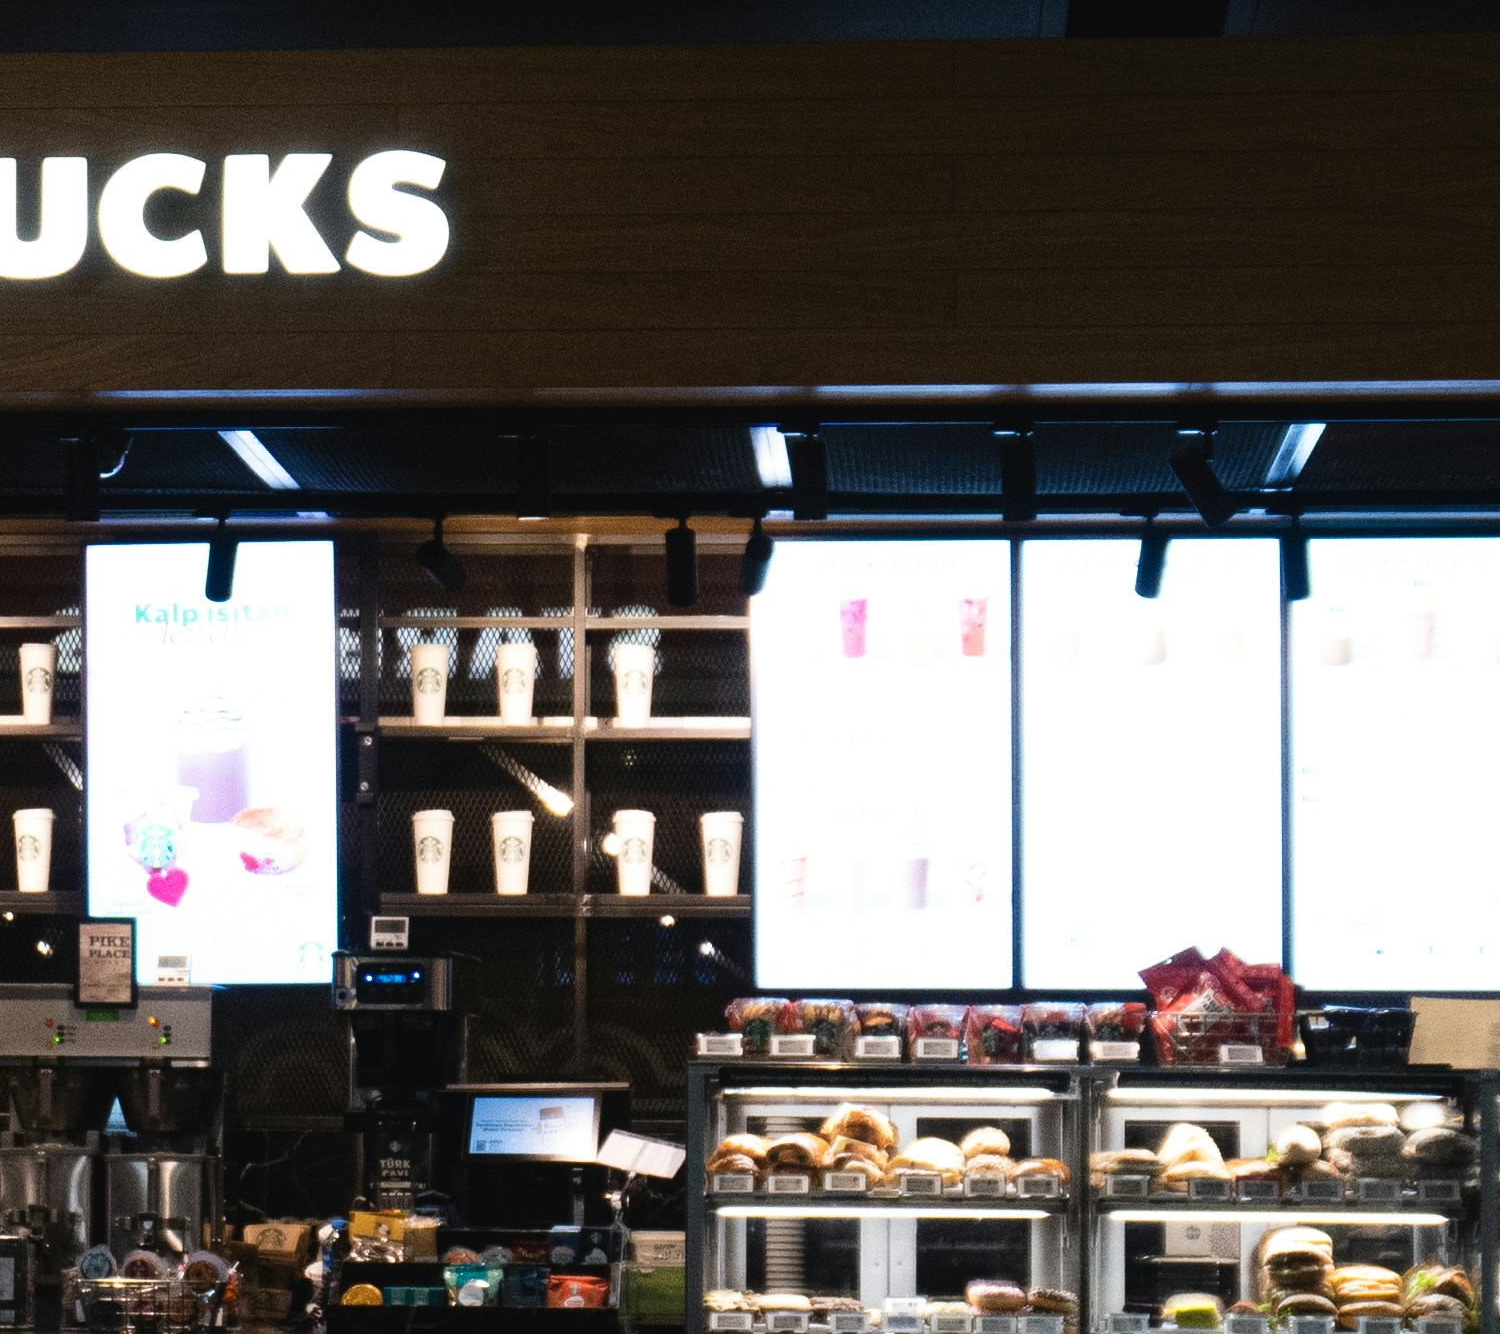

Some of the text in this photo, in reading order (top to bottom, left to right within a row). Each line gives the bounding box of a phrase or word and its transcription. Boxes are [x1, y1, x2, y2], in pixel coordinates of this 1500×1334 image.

[134, 602, 200, 627] Kalp
[89, 935, 130, 947] PIKE
[89, 948, 130, 959] PLACE
[379, 1157, 411, 1169] TÜRK
